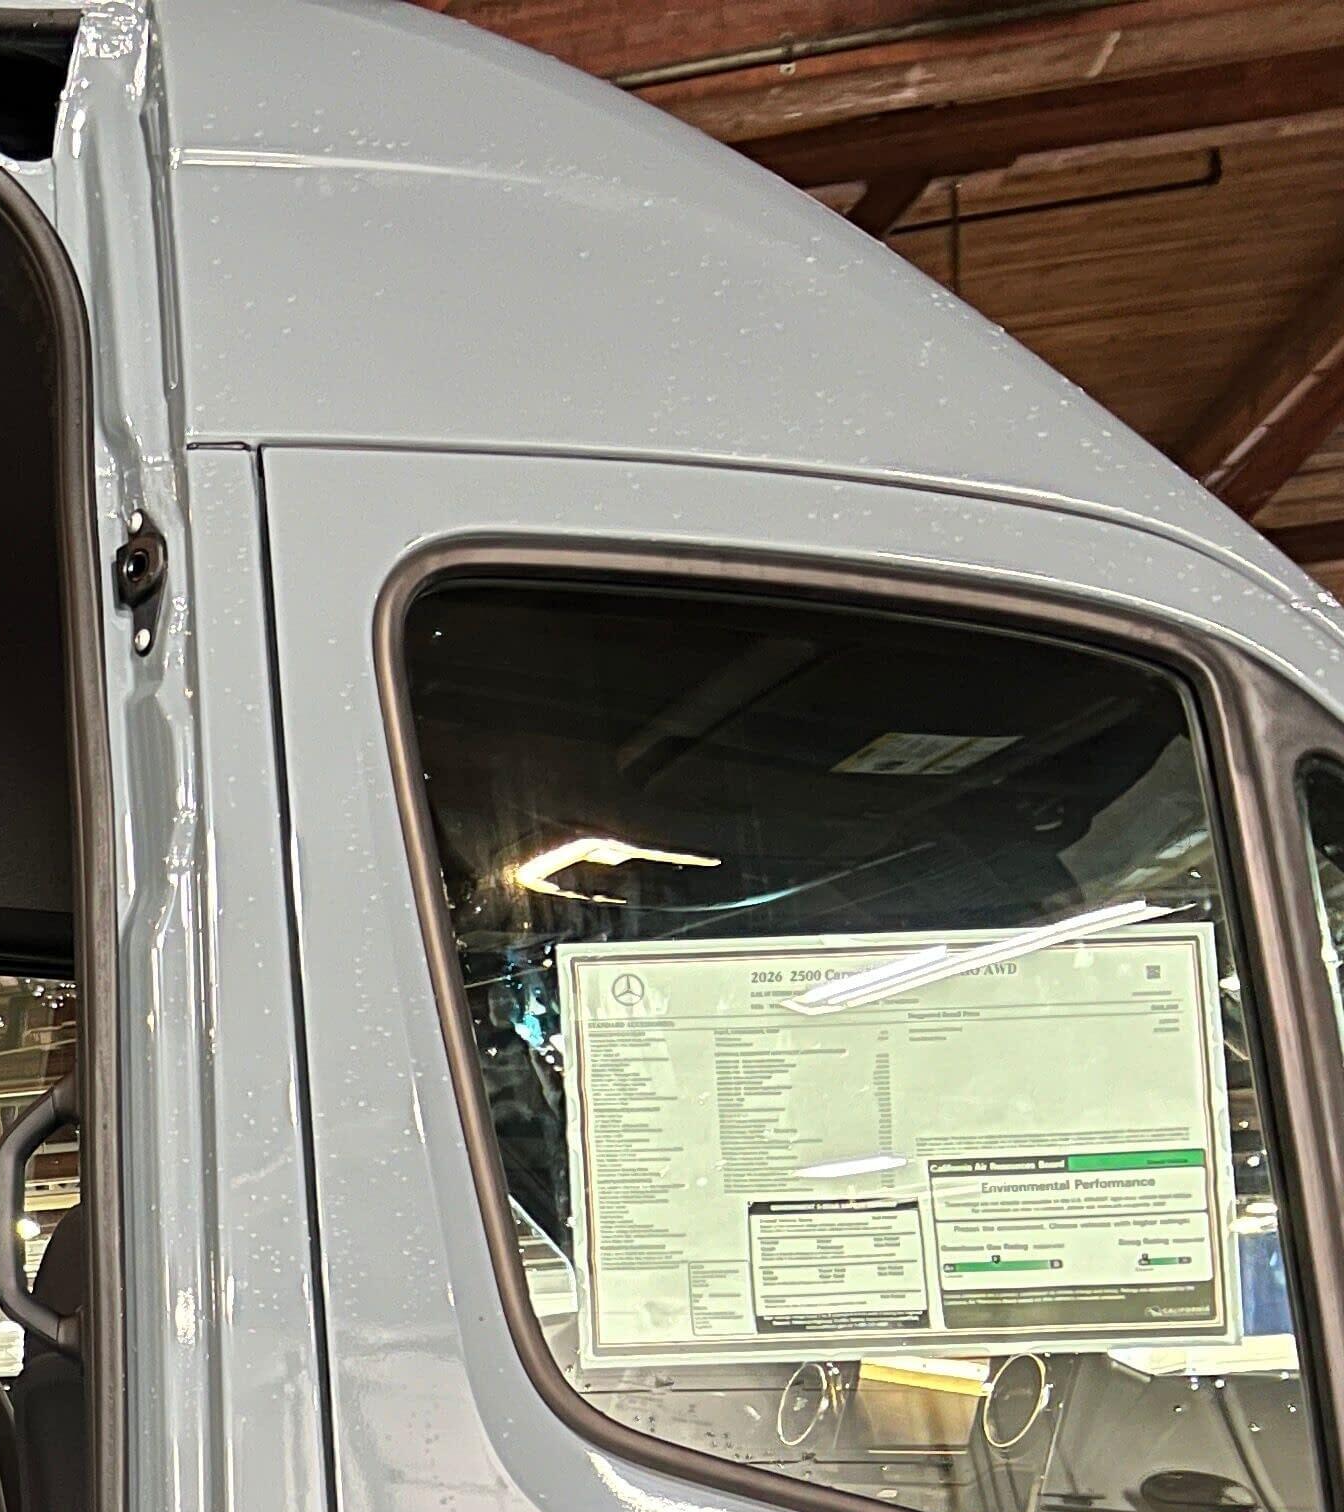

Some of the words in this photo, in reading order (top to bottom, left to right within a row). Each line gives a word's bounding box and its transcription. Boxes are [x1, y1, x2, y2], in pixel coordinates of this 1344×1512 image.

[751, 971, 783, 983] 2026
[790, 970, 822, 982] 2500
[984, 962, 1018, 976] AWD
[981, 1180, 1070, 1193] Environmental
[1074, 1178, 1156, 1190] Performance
